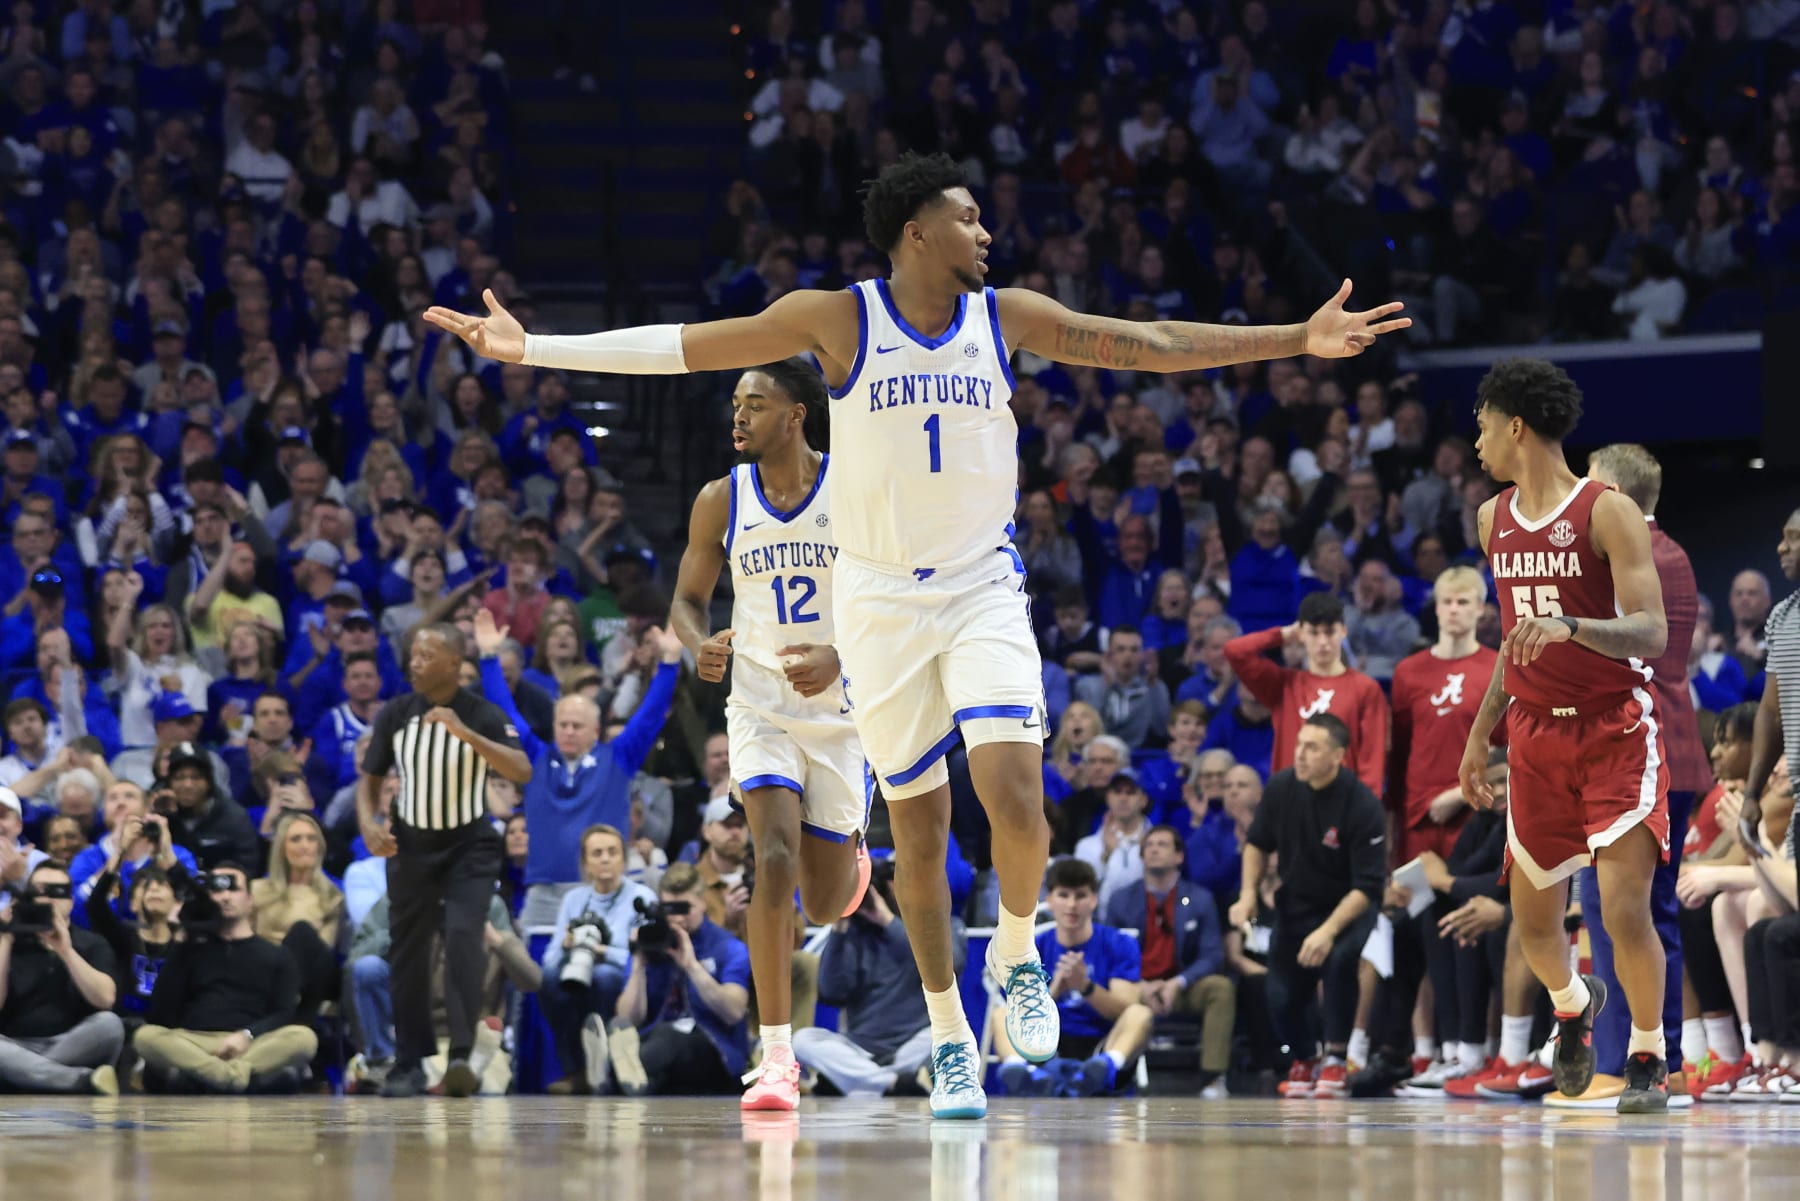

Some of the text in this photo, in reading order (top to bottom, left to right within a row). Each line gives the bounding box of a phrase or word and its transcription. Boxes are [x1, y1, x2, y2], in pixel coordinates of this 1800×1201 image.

[869, 374, 992, 412] KENTUCKY
[923, 413, 941, 473] 1
[1553, 521, 1571, 541] SEC
[739, 542, 839, 576] KENTUCKY
[1493, 551, 1583, 578] ALABAMA
[771, 575, 820, 625] 12
[1511, 585, 1564, 621] 55
